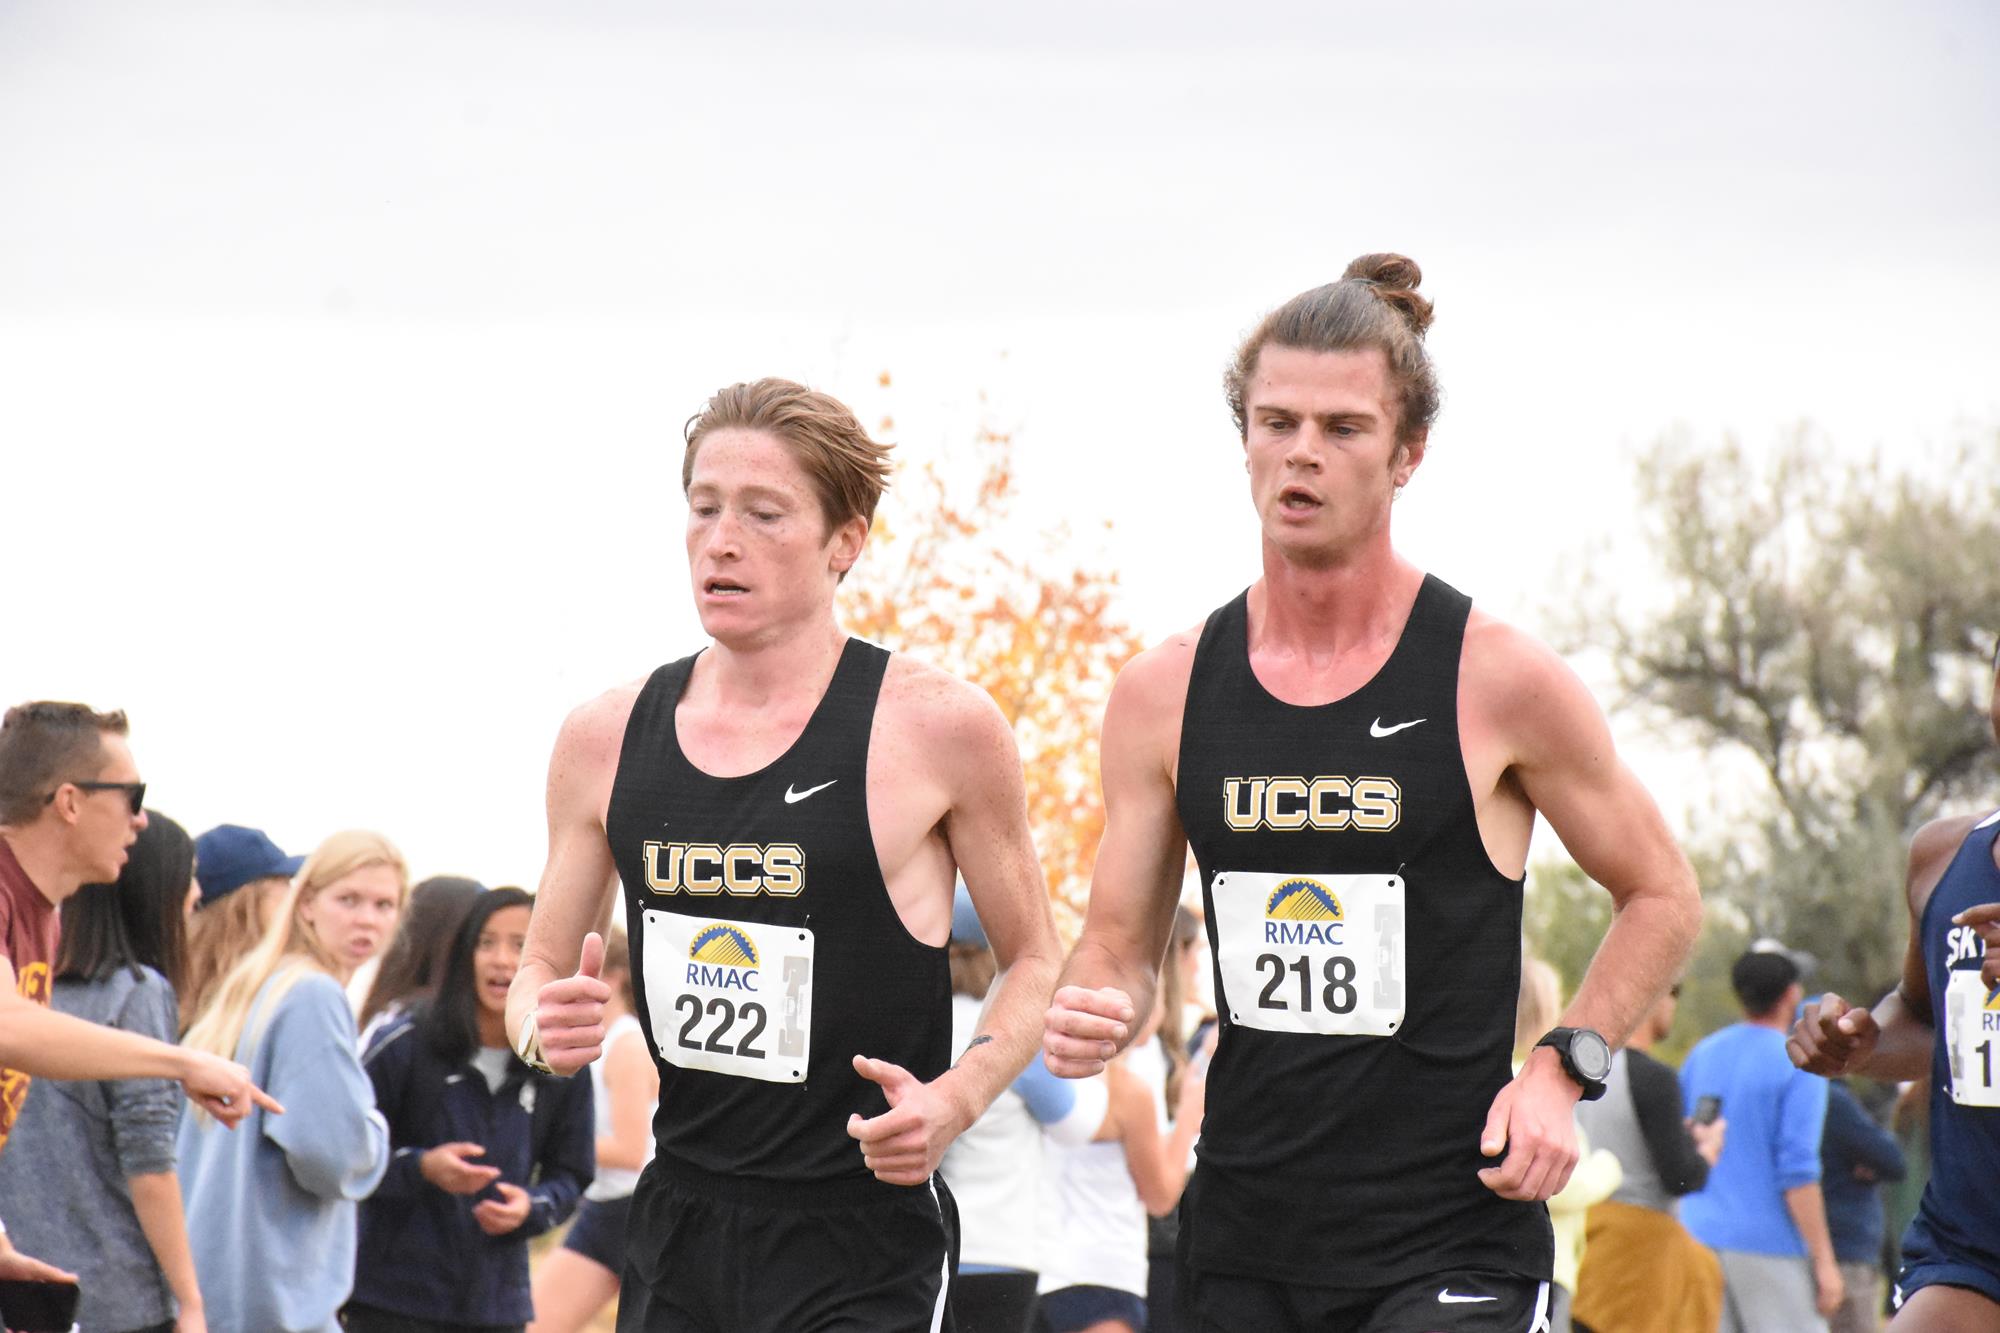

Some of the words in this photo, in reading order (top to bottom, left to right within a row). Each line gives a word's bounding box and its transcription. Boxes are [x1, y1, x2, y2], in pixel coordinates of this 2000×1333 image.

[1223, 776, 1401, 832] UCCS
[643, 840, 806, 897] UCCS
[1265, 921, 1344, 945] RMAC
[1945, 925, 1986, 967] SK
[686, 963, 759, 992] RMAC
[1255, 953, 1358, 1015] 218
[675, 994, 767, 1060] 222
[1982, 1012, 2000, 1031] R
